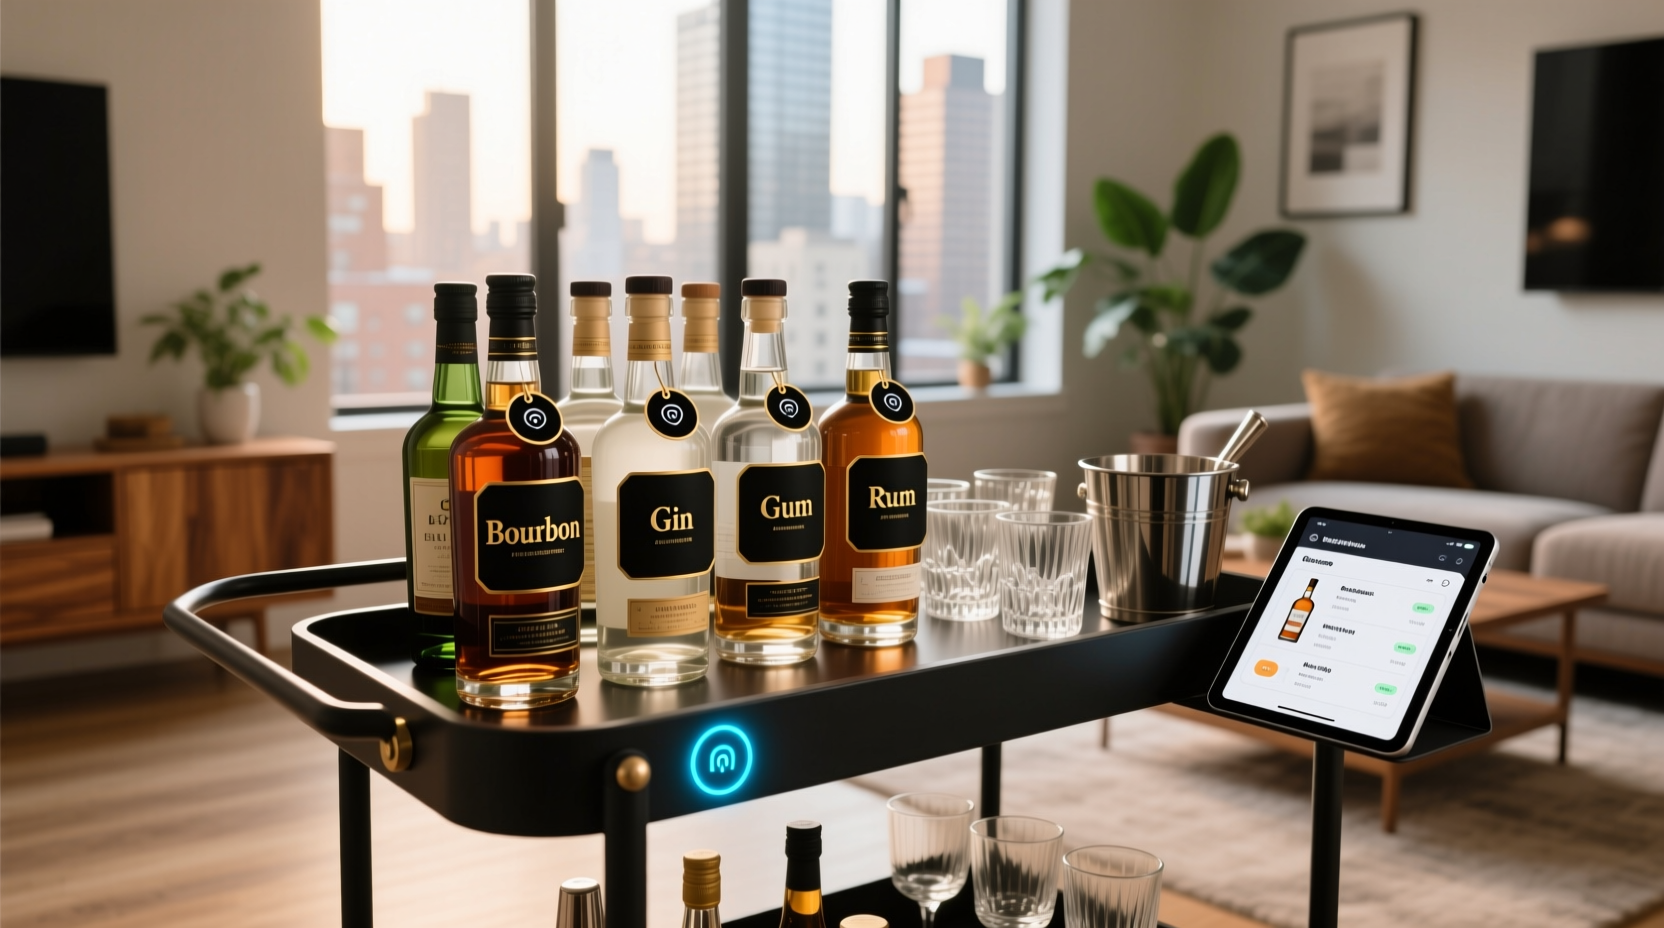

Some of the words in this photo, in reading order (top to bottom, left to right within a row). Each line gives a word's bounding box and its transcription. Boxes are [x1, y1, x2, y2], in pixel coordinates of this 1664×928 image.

[760, 495, 813, 519] Gum
[869, 486, 916, 509] Rum
[486, 516, 580, 546] Bourbon
[650, 506, 694, 532] Gin
